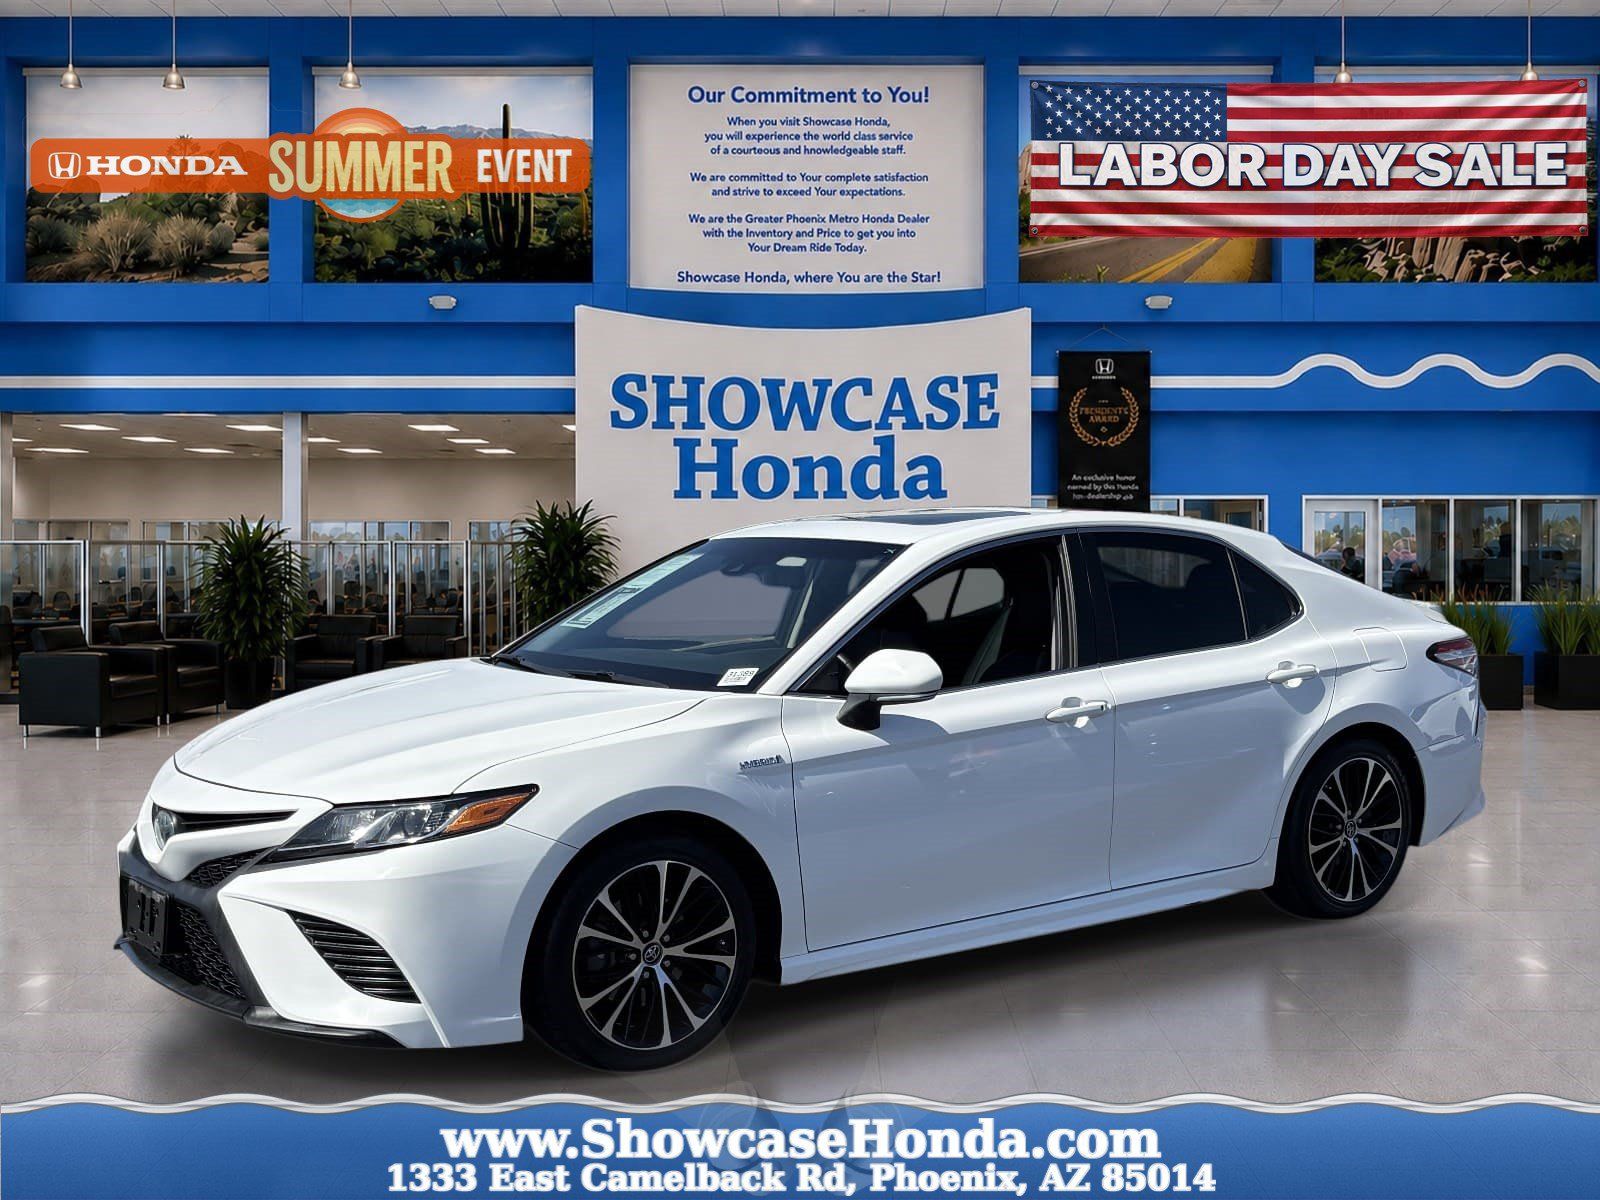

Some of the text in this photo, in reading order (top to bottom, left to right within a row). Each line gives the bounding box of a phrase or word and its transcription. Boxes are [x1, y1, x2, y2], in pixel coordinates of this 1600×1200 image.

[687, 85, 929, 104] Our Commitment to You!
[726, 115, 891, 129] When you visit Showcase Honda,
[704, 130, 914, 144] you will experience the world class service
[710, 144, 721, 155] of
[722, 147, 730, 155] a
[730, 146, 781, 156] courteous
[782, 144, 802, 155] and
[881, 144, 906, 155] staff.
[1059, 142, 1568, 188] LABOR DAY SALE
[689, 171, 929, 185] We are committed to Your complete satisfaction
[711, 186, 906, 200] and strive to exceed Your expectations.
[688, 213, 931, 224] We are the Greater Phoenix Metro Honda Dealer
[702, 227, 917, 241] with the Inventory and Price to get you into
[747, 242, 868, 255] Your Dream Ride Today.
[677, 270, 941, 286] Showcase Honda, where You are the Star!
[610, 373, 1000, 431] SHOWCASE
[673, 434, 948, 500] Honda
